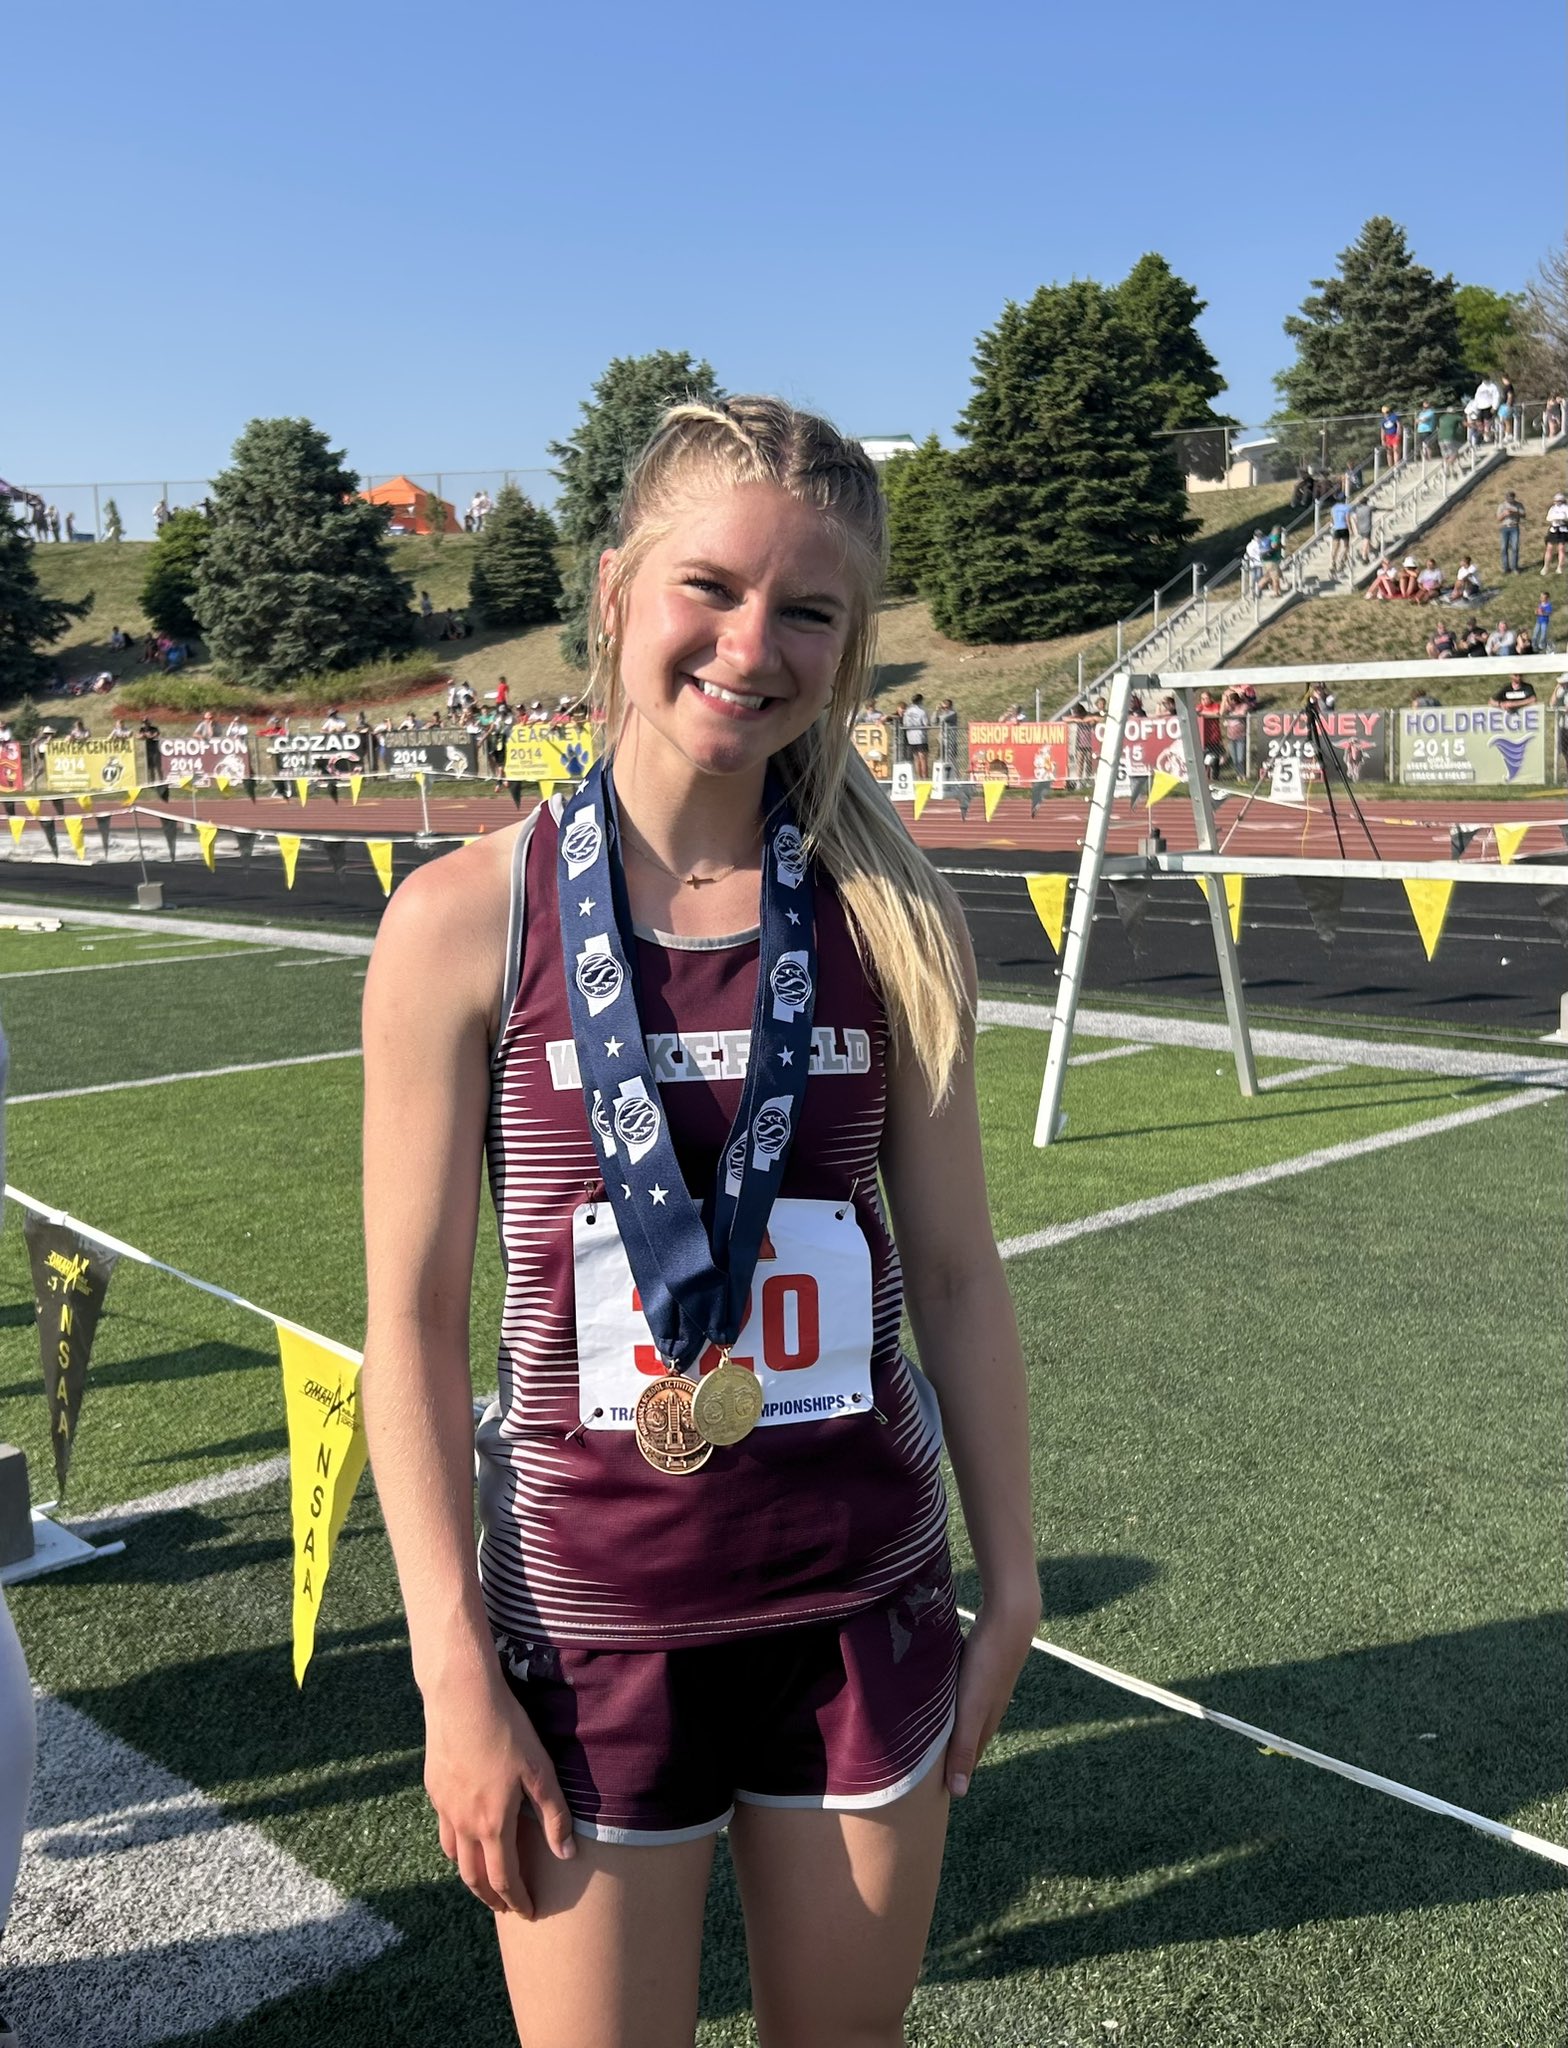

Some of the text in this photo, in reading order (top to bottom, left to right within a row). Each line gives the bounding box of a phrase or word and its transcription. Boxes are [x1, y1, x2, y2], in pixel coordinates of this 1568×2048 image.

[1095, 718, 1181, 741] COFTO
[1263, 713, 1380, 736] SIDNEY
[1406, 710, 1539, 735] HOLDREGE
[274, 734, 360, 752] COZAD
[855, 729, 882, 746] ER
[970, 725, 1065, 744] BISHOP NEUMANN
[160, 738, 248, 756] CROFTON
[510, 748, 542, 760] 2014
[986, 748, 1014, 763] 015
[1413, 739, 1465, 757] 2015
[55, 757, 85, 771] 2014
[170, 757, 203, 771] 2014
[393, 750, 427, 764] 2014
[898, 773, 908, 790] 8
[1280, 763, 1293, 783] 5
[545, 1027, 871, 1091] WKEFLD
[642, 1383, 664, 1403] SCHOOL
[609, 1394, 846, 1421] TRA MPIONSHIPS
